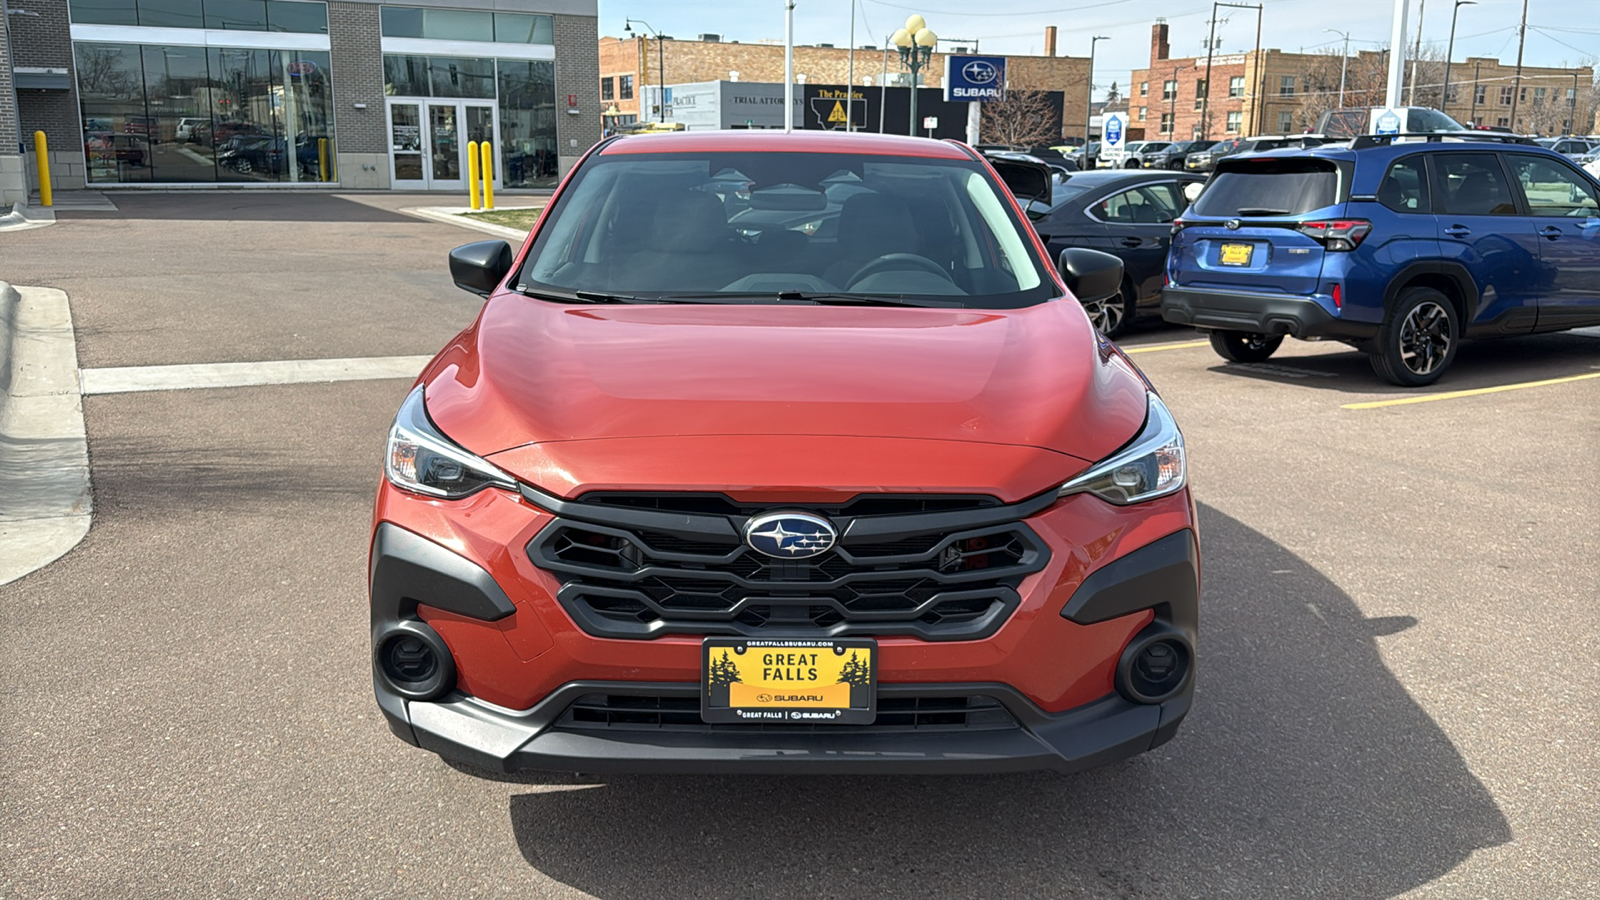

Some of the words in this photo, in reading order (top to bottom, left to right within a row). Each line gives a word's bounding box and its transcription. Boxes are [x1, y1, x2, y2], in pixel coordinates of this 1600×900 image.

[818, 89, 833, 98] The
[834, 90, 864, 99] Pratice
[953, 87, 1002, 97] SUBARU
[733, 96, 758, 105] TRIAL
[759, 97, 804, 106] ATTORYS
[763, 653, 818, 666] GREAT
[763, 667, 818, 681] FALLS
